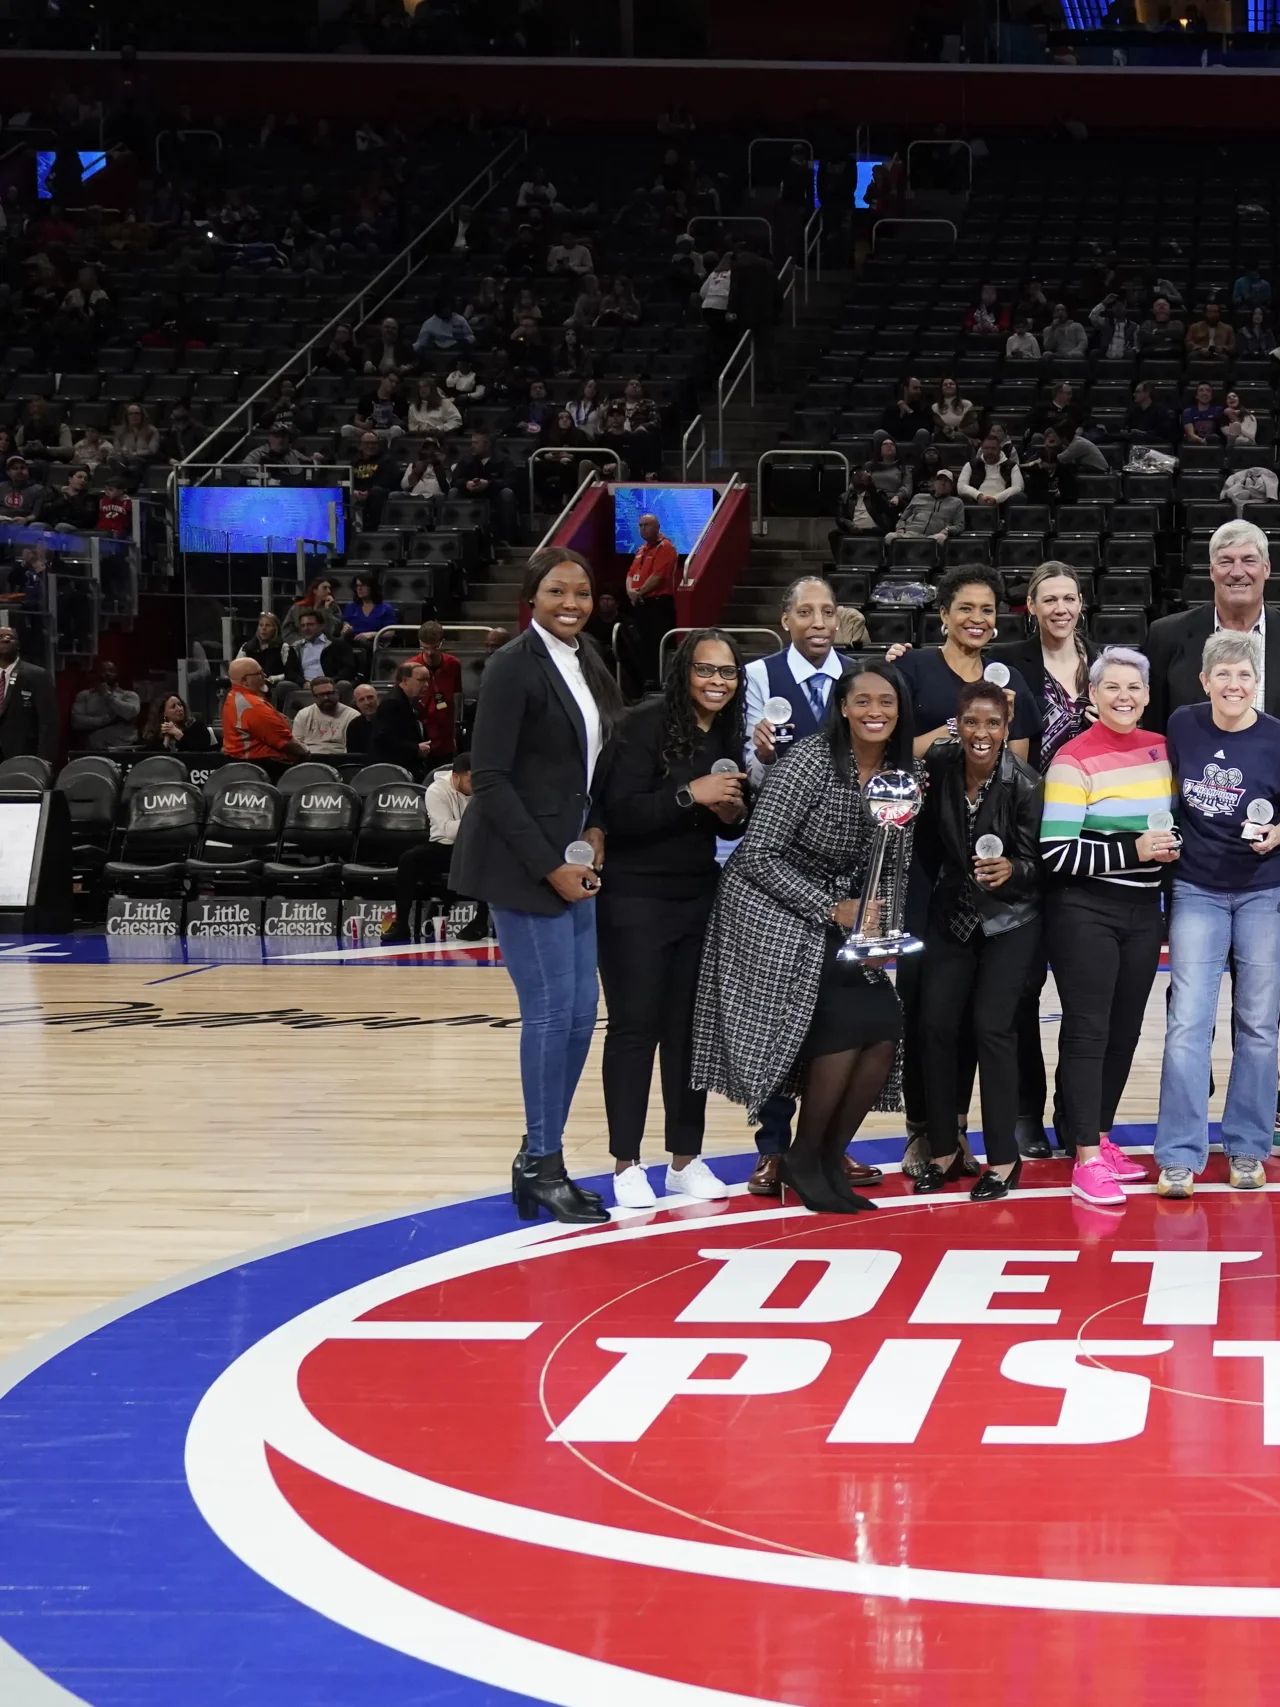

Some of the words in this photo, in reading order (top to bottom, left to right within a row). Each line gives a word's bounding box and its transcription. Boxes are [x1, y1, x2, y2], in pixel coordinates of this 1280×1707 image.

[144, 792, 187, 809] UWM
[224, 792, 268, 808] UWM
[301, 795, 343, 809] UWM
[378, 794, 420, 809] UWM
[1192, 784, 1238, 802] CHAMPIONS
[122, 902, 171, 920] Little
[202, 904, 250, 923] Little
[279, 902, 327, 921] Little
[107, 916, 176, 935] Caesars
[187, 920, 256, 936] Caesars
[264, 917, 332, 936] Caesars
